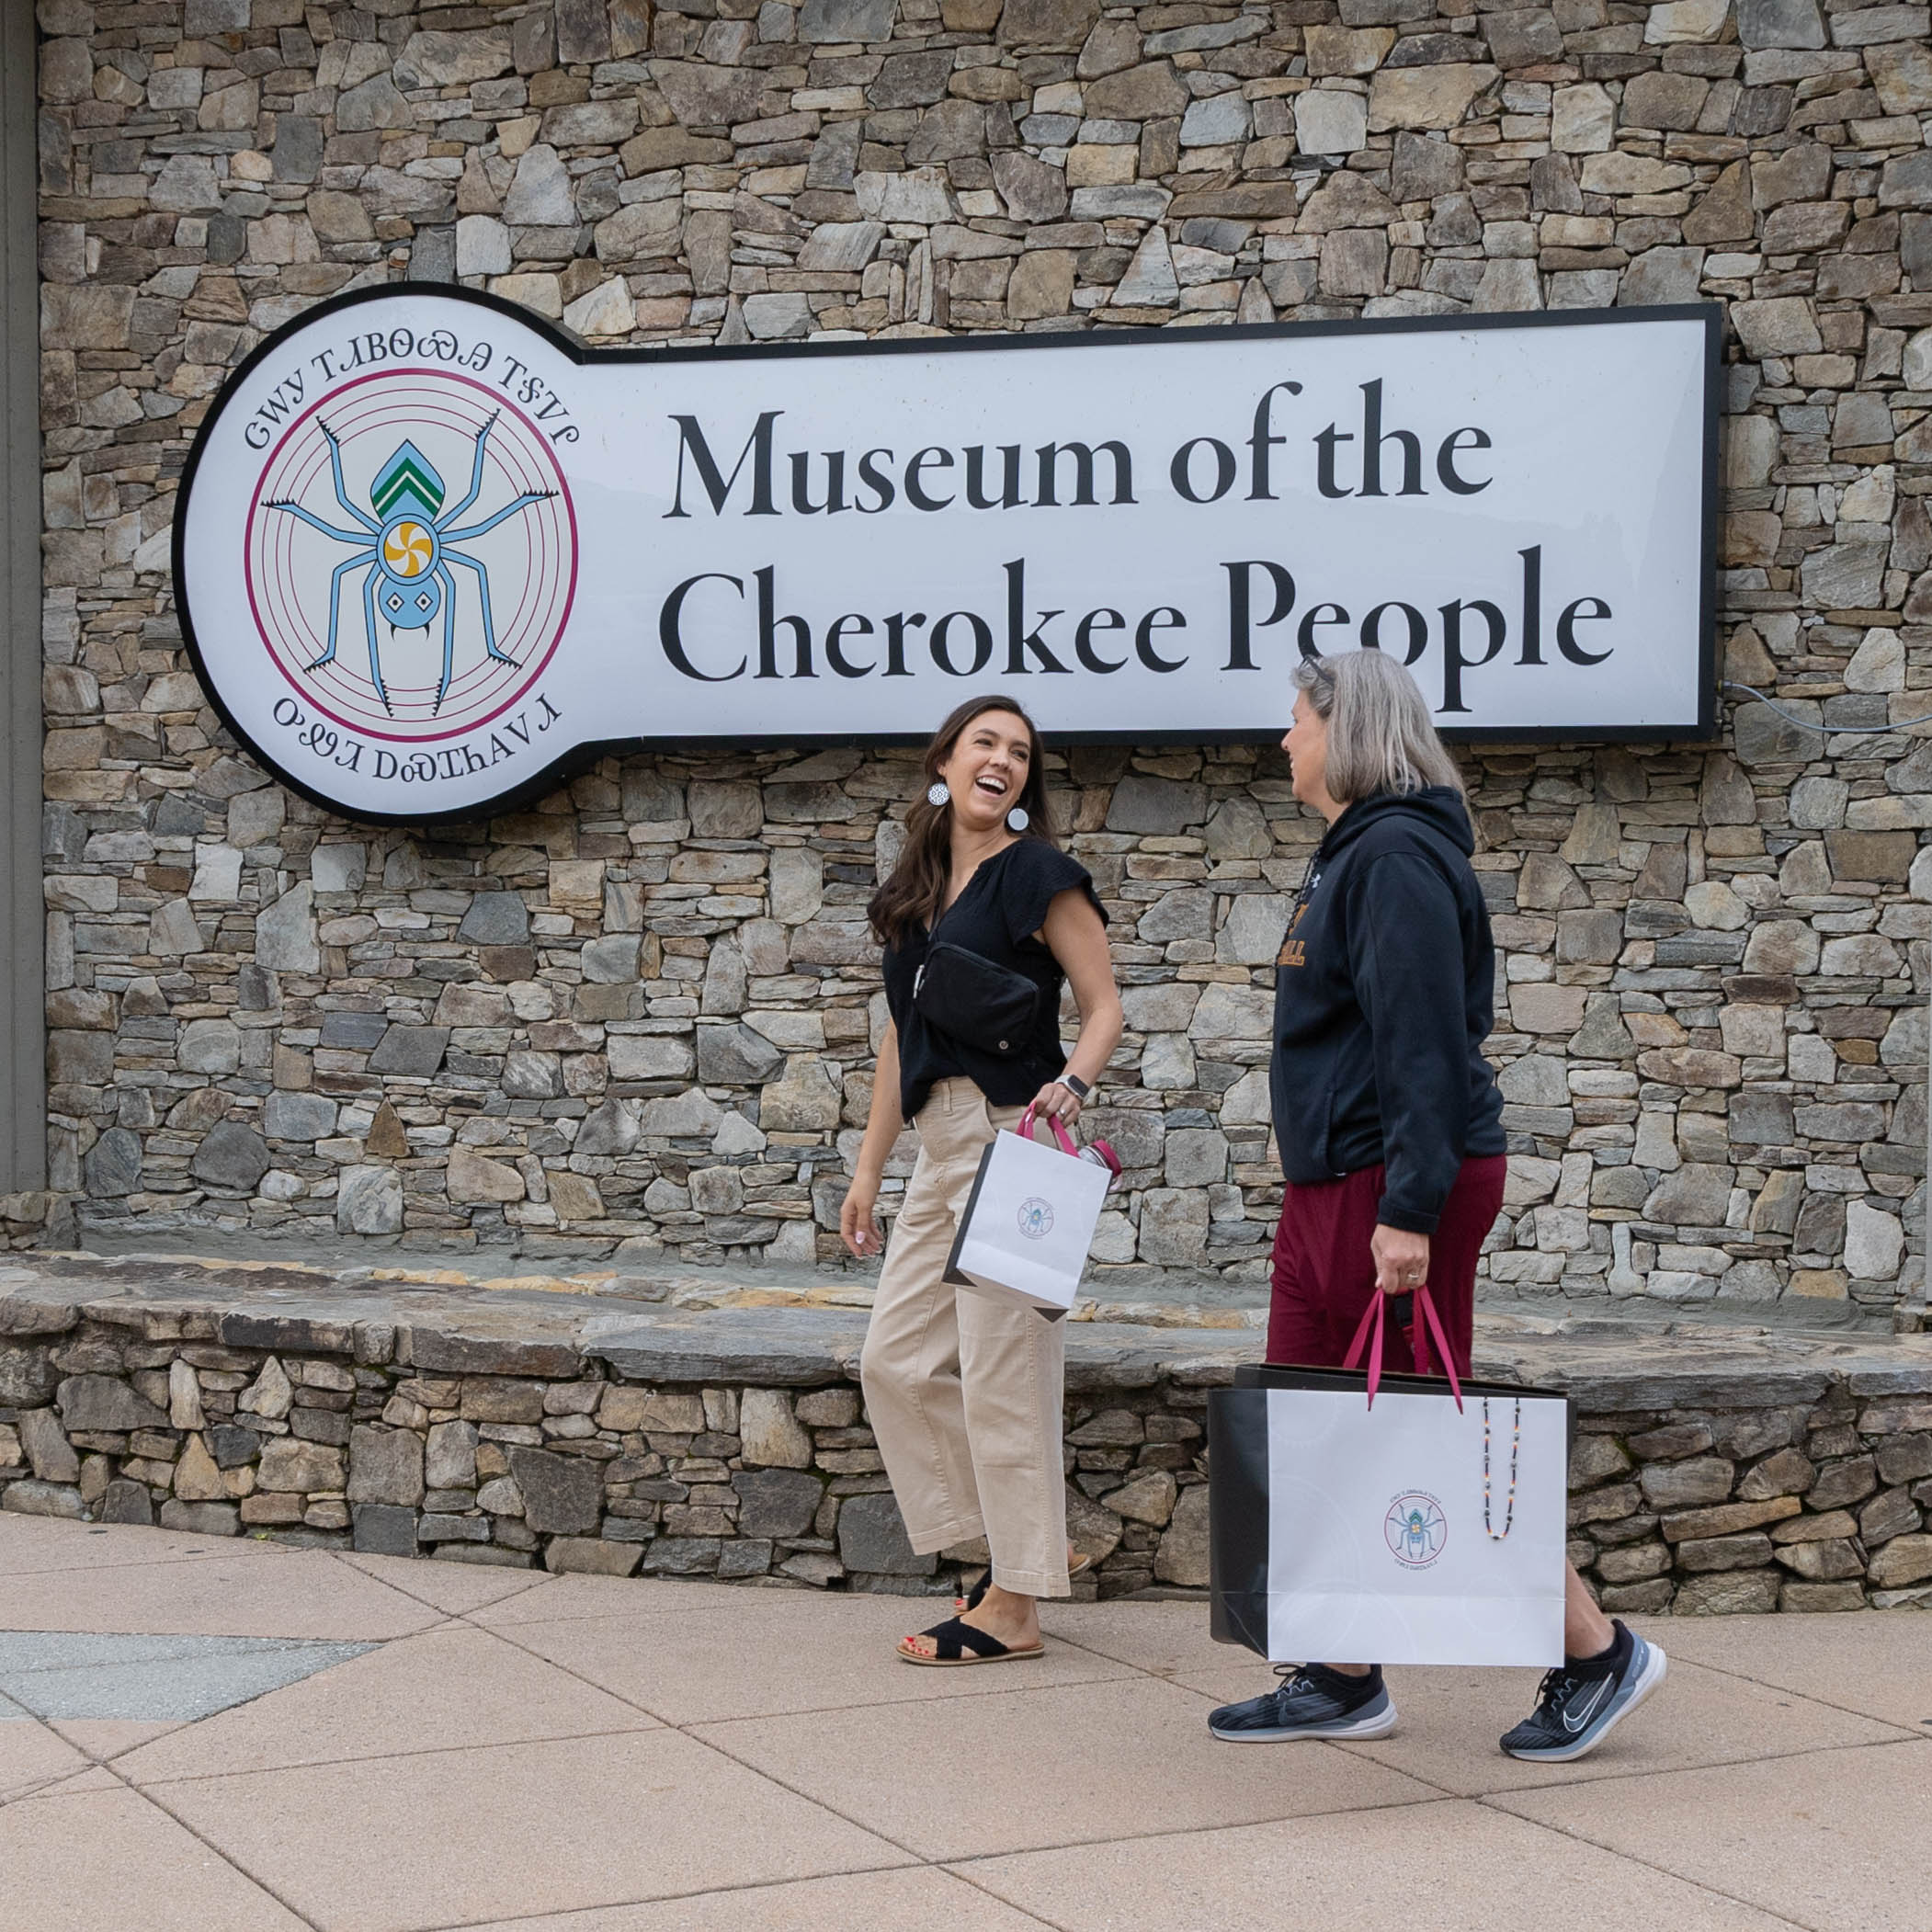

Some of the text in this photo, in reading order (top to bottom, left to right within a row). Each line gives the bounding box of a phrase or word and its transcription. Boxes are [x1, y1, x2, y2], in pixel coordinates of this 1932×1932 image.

[661, 377, 1494, 519] Museum of the
[659, 543, 1614, 714] Cherokee People
